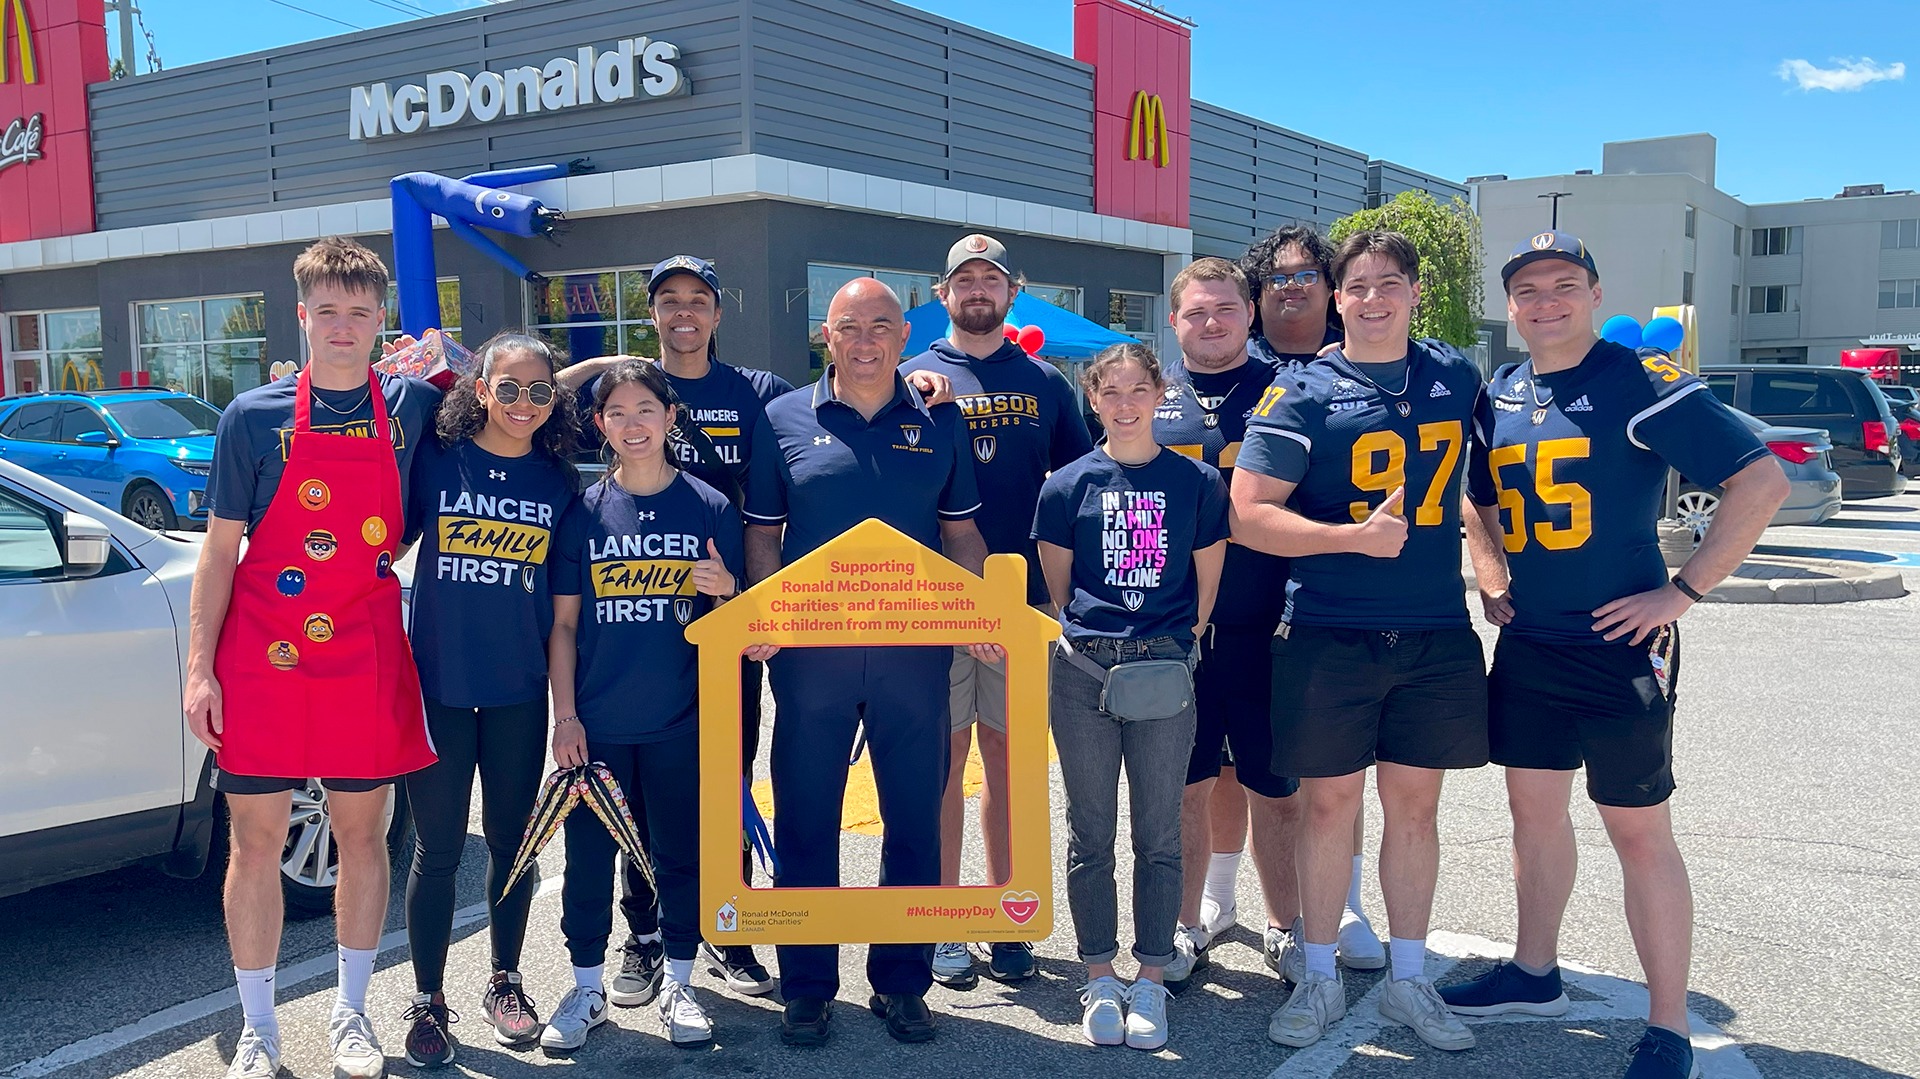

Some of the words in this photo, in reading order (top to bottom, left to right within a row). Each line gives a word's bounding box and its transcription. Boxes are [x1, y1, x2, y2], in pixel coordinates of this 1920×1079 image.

[349, 36, 682, 141] McDonald's
[0, 114, 39, 162] Café
[690, 409, 739, 422] LANCERS
[955, 395, 1039, 416] NDSOR
[969, 417, 1020, 430] NCERS
[672, 443, 741, 464] KETALL
[1349, 420, 1463, 526] 97
[1101, 491, 1120, 510] IN
[1124, 490, 1167, 510] THIS
[1488, 437, 1593, 553] 55
[438, 490, 552, 527] LANCER
[1103, 510, 1166, 530] FAMILY
[446, 519, 546, 562] FAMILY
[588, 533, 700, 561] LANCER
[1102, 530, 1128, 550] NO
[1132, 529, 1169, 549] ONE
[830, 560, 915, 576] Supporting
[1103, 549, 1167, 569] FIGHTS
[437, 556, 519, 587] FIRST
[599, 562, 694, 597] FAMILY
[1104, 568, 1162, 588] ALONE
[781, 580, 834, 593] Ronald
[837, 579, 913, 592] McDonald
[916, 579, 964, 592] House
[596, 598, 669, 624] FIRST
[847, 599, 875, 612] and
[878, 598, 938, 611] families
[941, 598, 975, 611] with
[748, 619, 779, 632] sick
[781, 619, 843, 632] children
[846, 618, 882, 631] from
[885, 620, 907, 633] my
[911, 618, 1001, 632] community!
[906, 906, 996, 919] #McHappyDay
